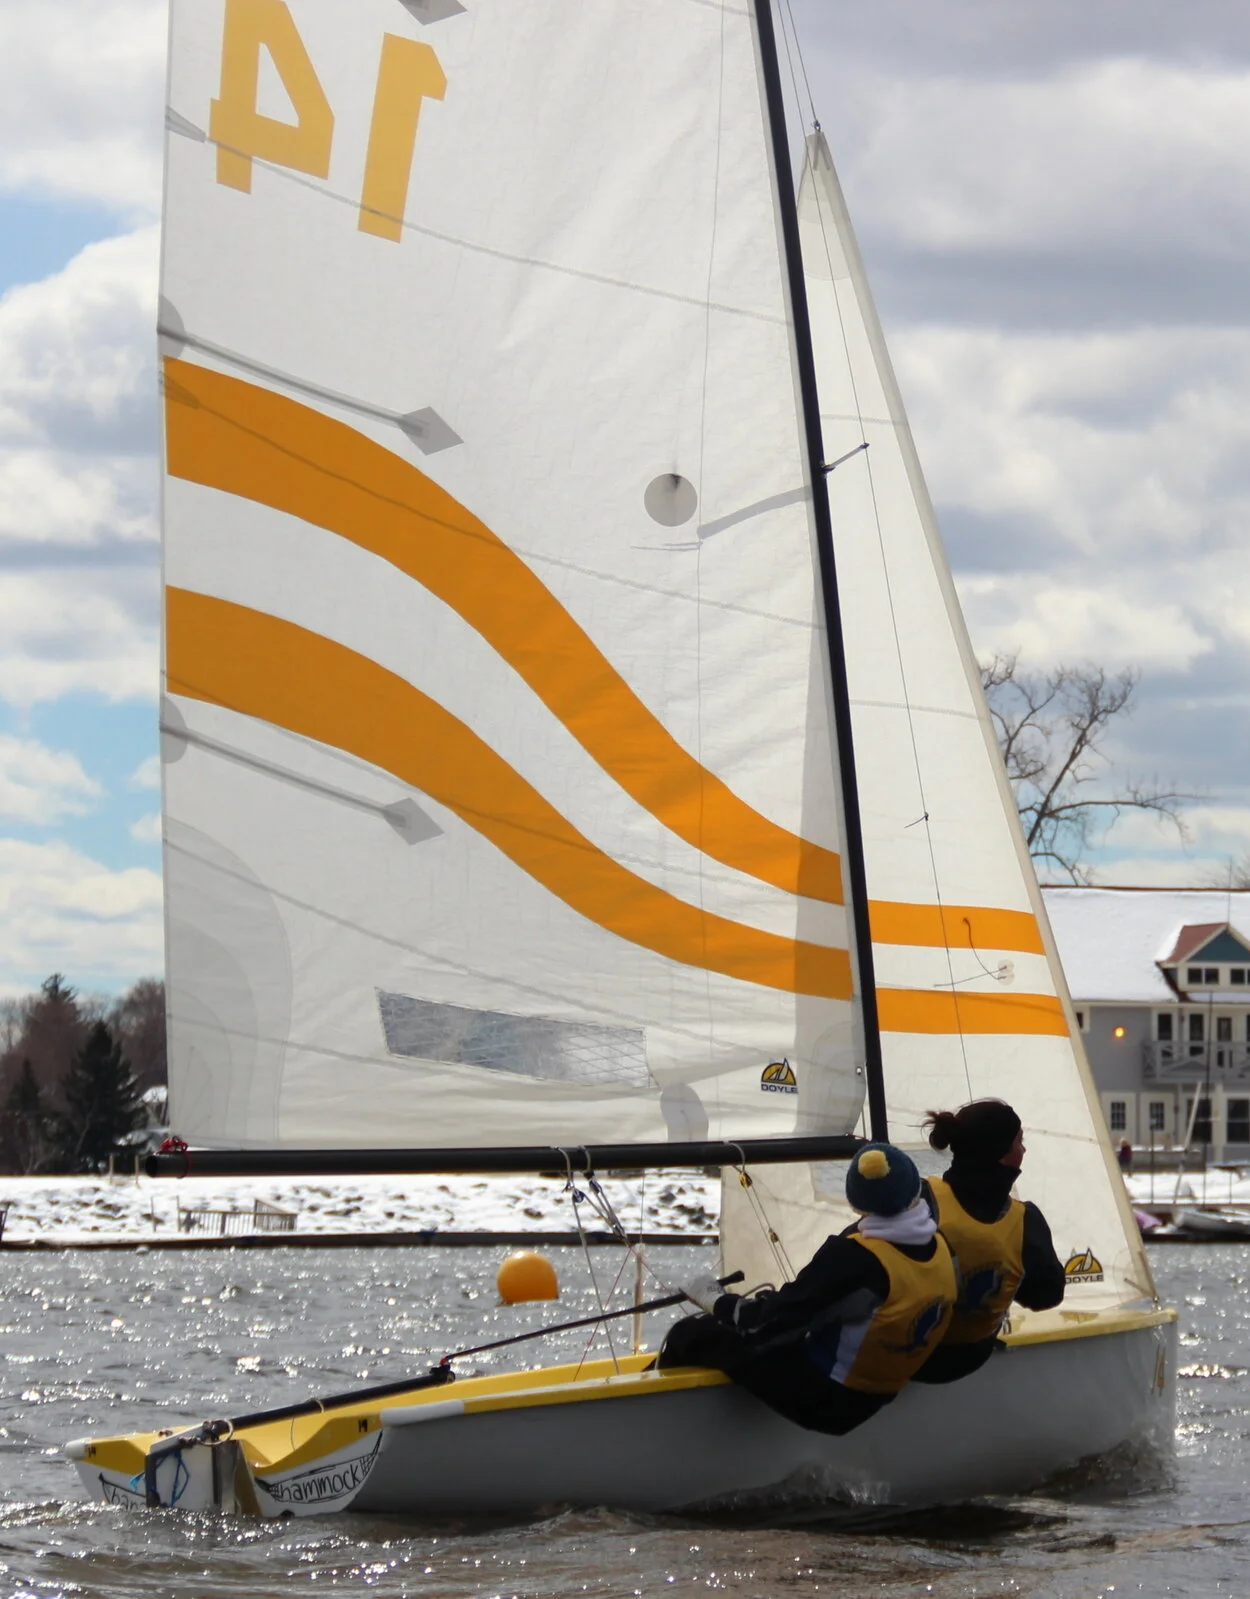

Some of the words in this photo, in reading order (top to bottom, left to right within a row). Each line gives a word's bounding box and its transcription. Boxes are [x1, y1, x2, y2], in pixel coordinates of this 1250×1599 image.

[761, 1084, 798, 1094] DOYLE
[1065, 1274, 1104, 1284] DOYLE
[279, 1464, 361, 1500] hammock
